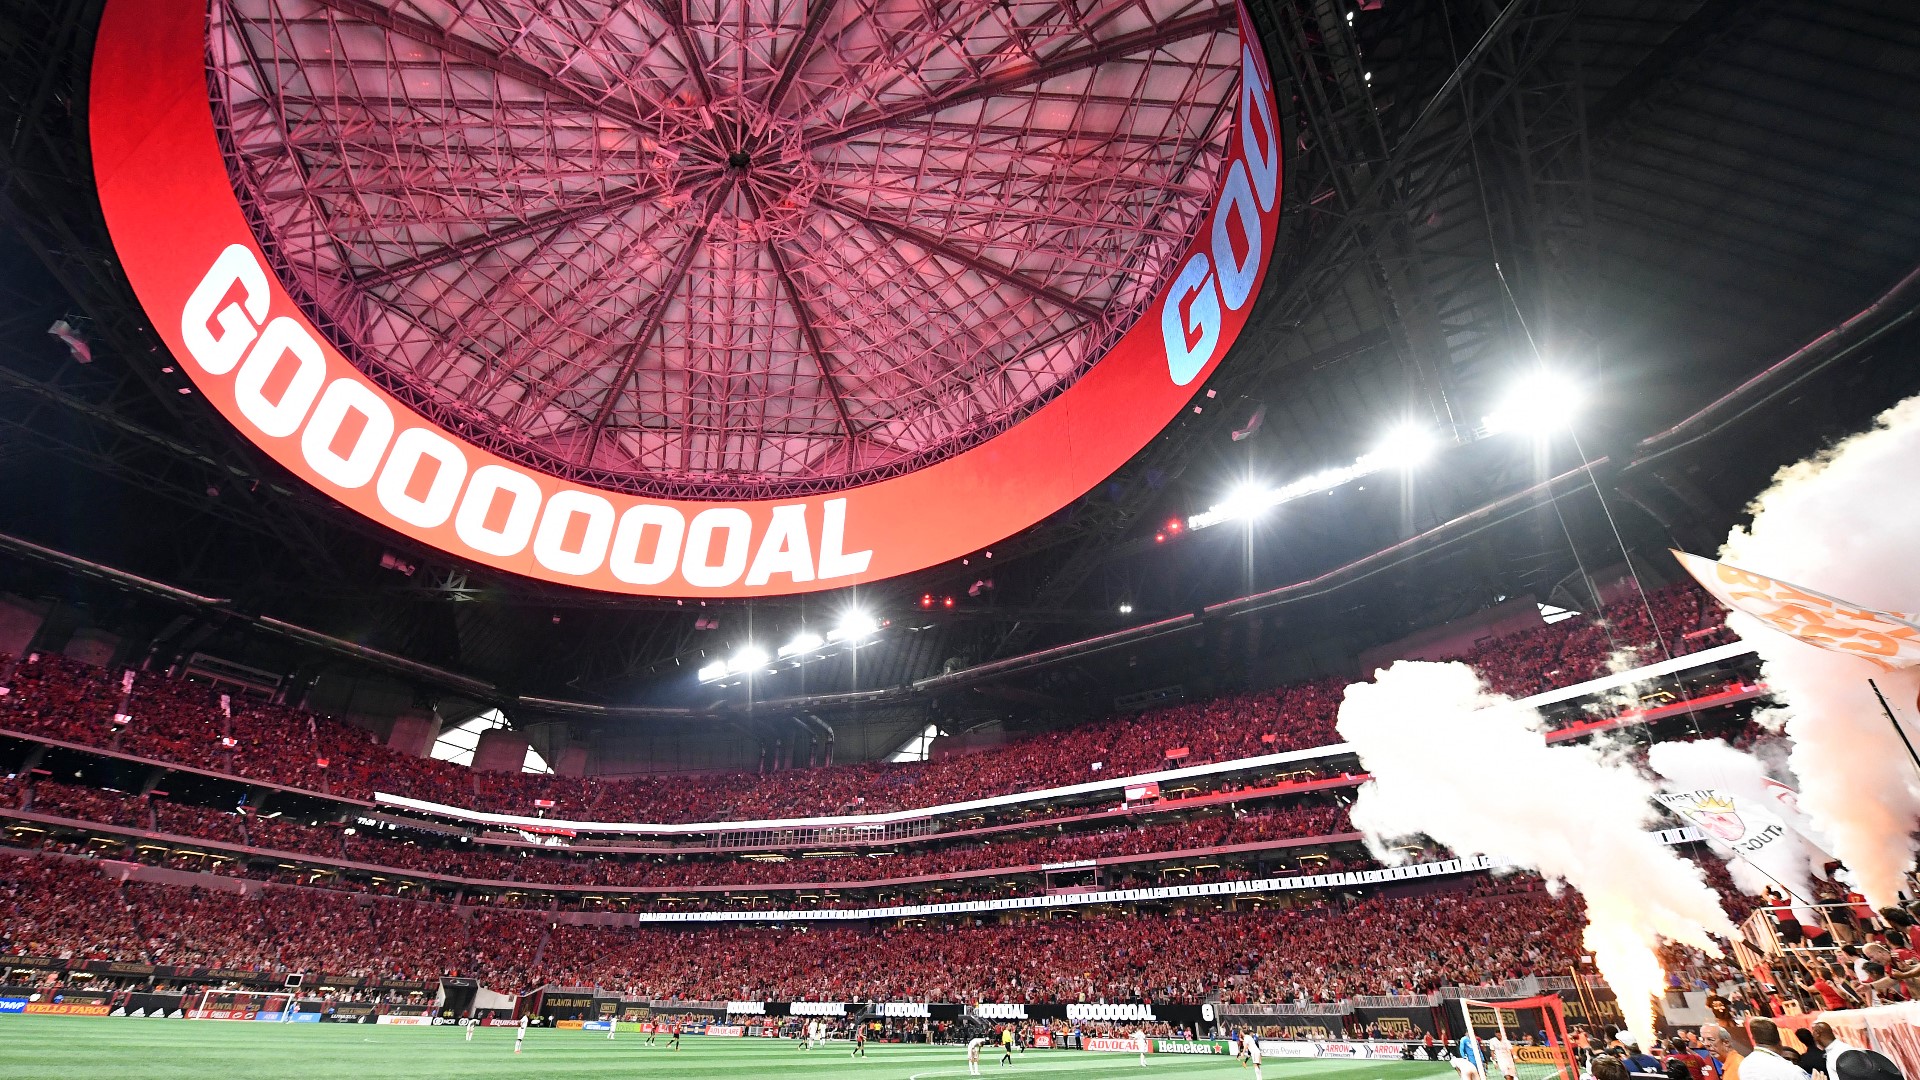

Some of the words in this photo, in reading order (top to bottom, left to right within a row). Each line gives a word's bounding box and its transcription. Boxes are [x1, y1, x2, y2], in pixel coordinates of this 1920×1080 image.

[181, 243, 873, 587] GOOOOOOOAL
[26, 1004, 68, 1013] WELLS
[70, 1006, 111, 1015] FARGO
[709, 1027, 739, 1036] ADVOCARE
[1090, 1040, 1140, 1050] ADVOCAR
[1158, 1041, 1212, 1053] Heineken
[1325, 1045, 1350, 1053] ARROW
[1374, 1045, 1400, 1053] ARROW
[1260, 1047, 1280, 1055] eorgia
